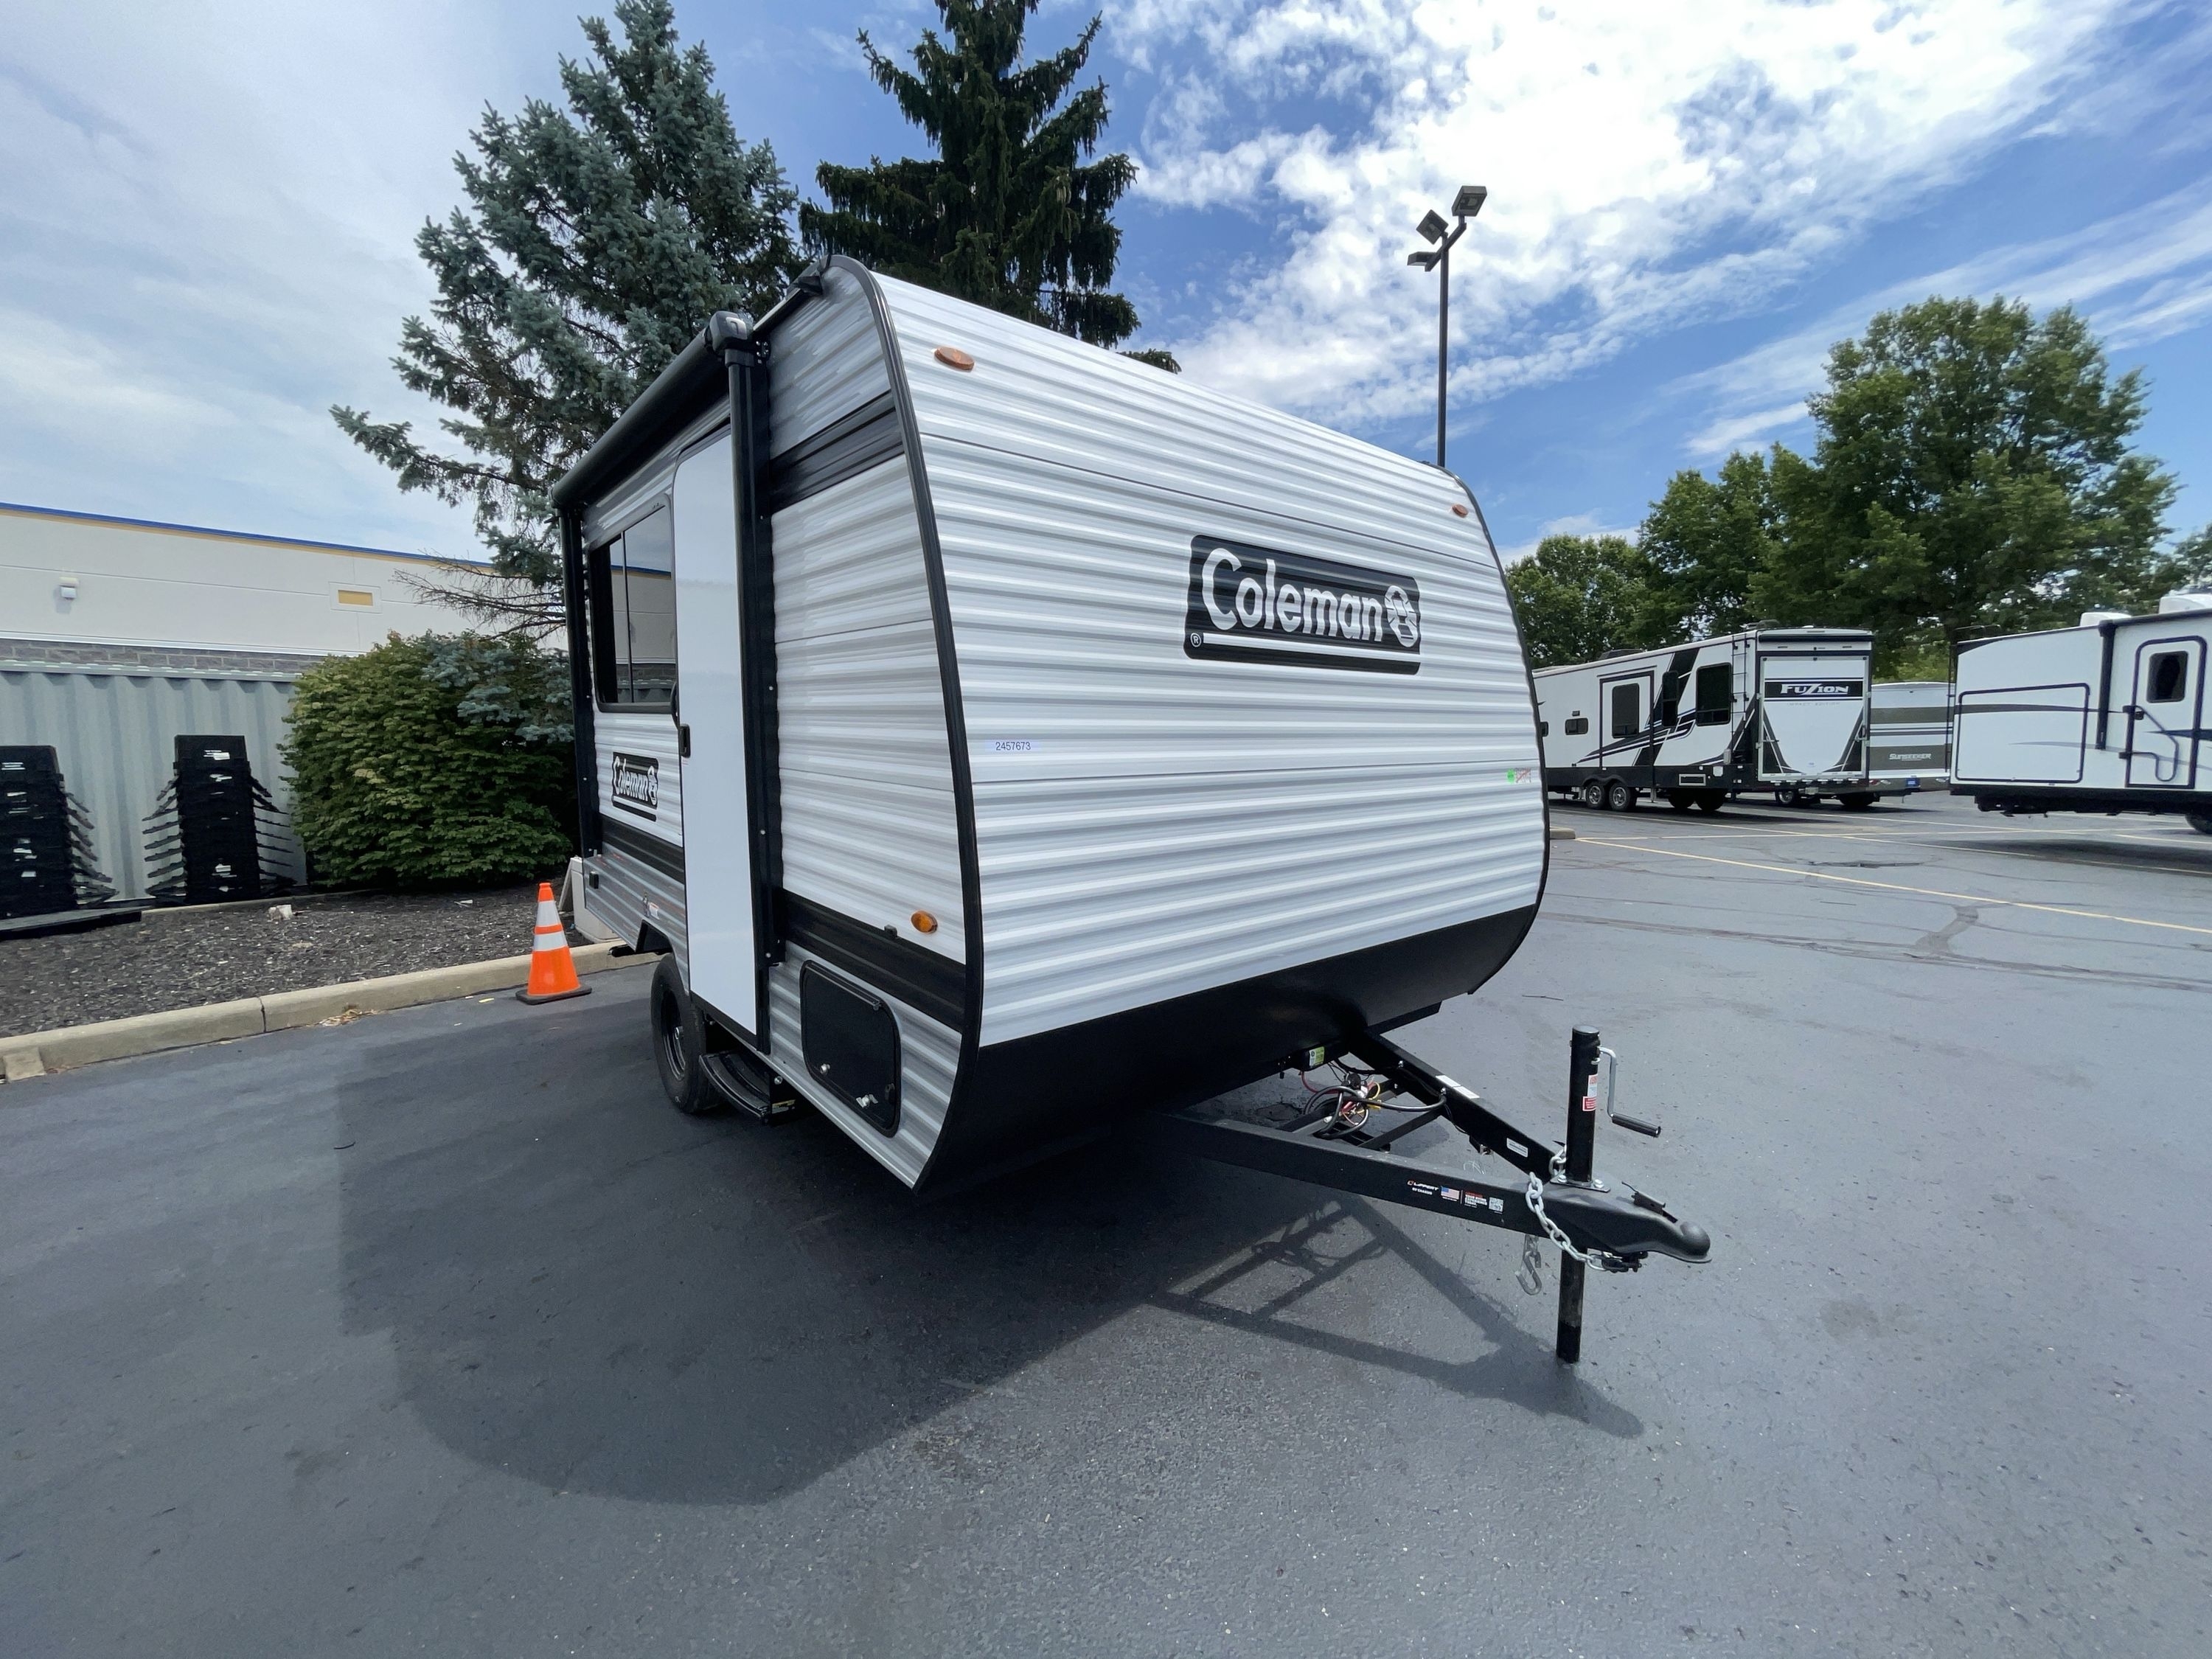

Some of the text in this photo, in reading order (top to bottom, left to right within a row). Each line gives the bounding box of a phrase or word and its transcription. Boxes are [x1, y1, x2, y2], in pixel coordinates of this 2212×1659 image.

[1202, 547, 1383, 642] Coleman
[1780, 683, 1849, 696] FUZION
[995, 741, 1032, 751] 2457673
[613, 756, 648, 801] Coleman
